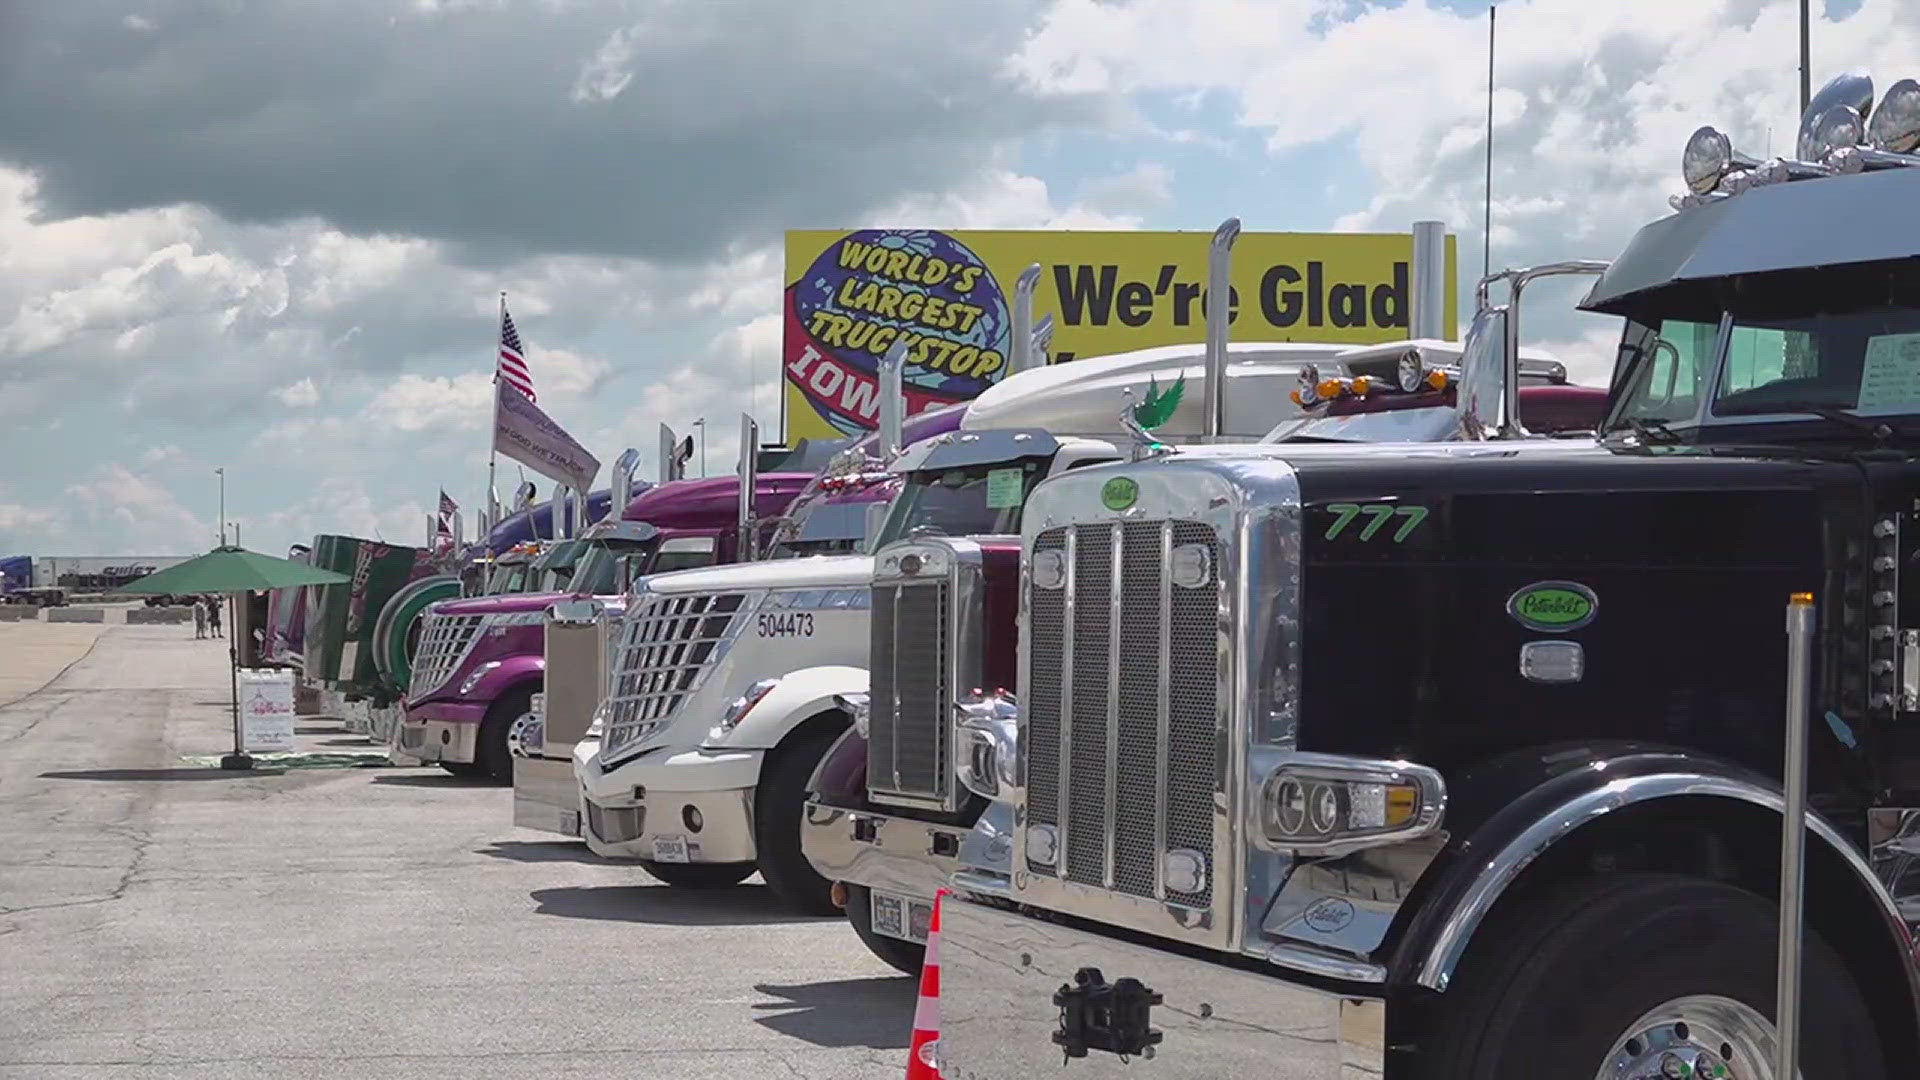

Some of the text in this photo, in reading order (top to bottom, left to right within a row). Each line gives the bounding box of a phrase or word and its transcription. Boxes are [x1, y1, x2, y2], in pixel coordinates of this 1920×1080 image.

[838, 240, 983, 293] WORLD'S
[838, 278, 983, 333] LARGEST
[1260, 261, 1409, 328] Glad
[788, 344, 908, 421] IOW
[1325, 504, 1429, 542] 777
[758, 612, 815, 638] 504473
[1522, 593, 1587, 615] Peterbilt
